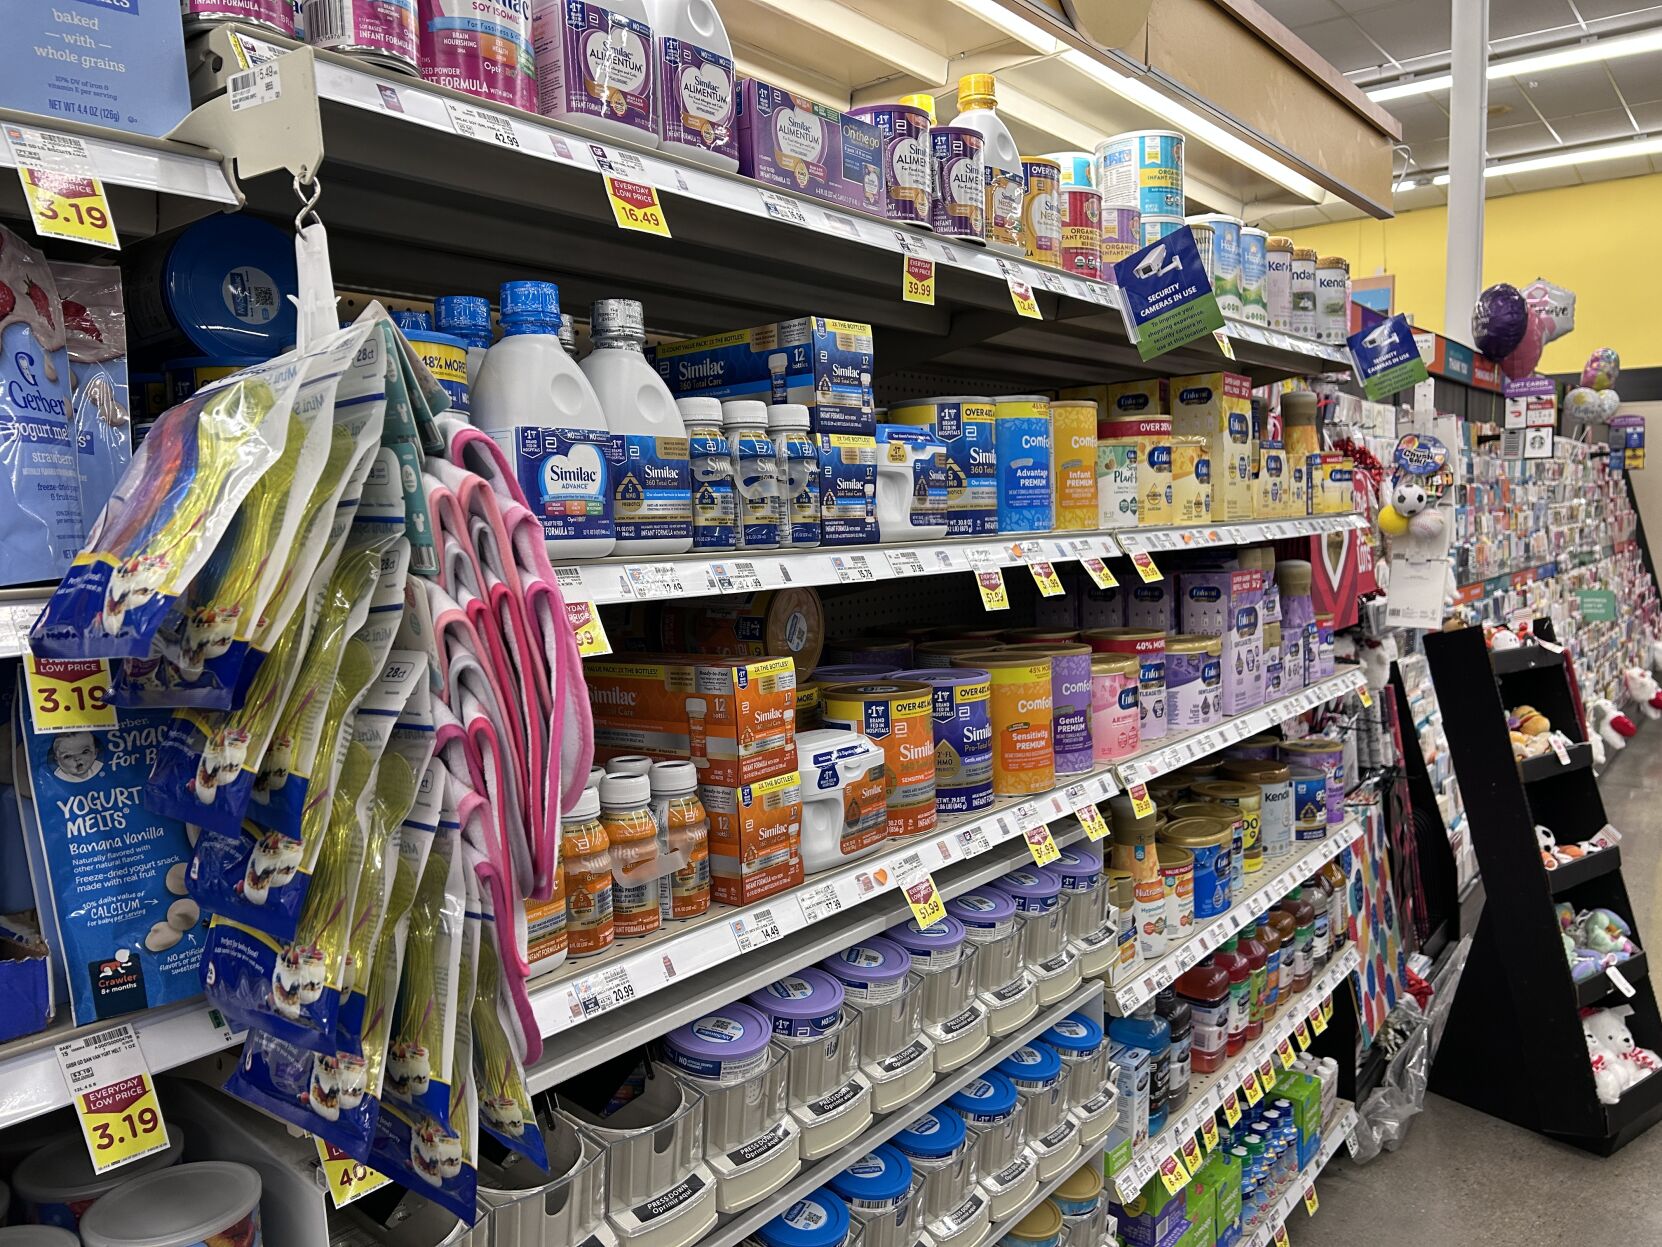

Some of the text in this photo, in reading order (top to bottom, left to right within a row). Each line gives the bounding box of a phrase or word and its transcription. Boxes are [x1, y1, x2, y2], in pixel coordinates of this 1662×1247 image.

[52, 8, 99, 30] baked
[472, 2, 492, 14] SOY
[493, 9, 521, 25] ISOMIL
[63, 32, 95, 48] with
[359, 30, 385, 42] INFANT
[385, 36, 412, 51] FORMULA
[443, 39, 478, 49] NOURISHING
[452, 32, 469, 40] BRAIN
[33, 45, 125, 73] whole grains
[258, 65, 273, 80] 5.49
[440, 77, 489, 93] FORMULA
[490, 87, 502, 96] WITH
[694, 75, 719, 94] Similac
[683, 83, 728, 106] ALIMENTUM
[48, 99, 120, 122] NET WT 4.4 OZ (126g)
[788, 115, 812, 133] Similac
[494, 132, 520, 147] 42.99
[778, 124, 820, 146] ALIMENTUM
[1032, 167, 1050, 176] OVER
[65, 181, 93, 194] PRICE
[614, 180, 650, 196] EVERYDAY
[615, 189, 653, 205] LOW PRICE
[37, 197, 108, 229] 3.19
[621, 206, 660, 228] 16.49
[934, 219, 952, 227] INFANT
[1070, 228, 1098, 236] ORGANIC
[1105, 243, 1135, 251] ORGANIC
[909, 260, 933, 269] EVERYDAY
[909, 281, 931, 298] 39.99
[1148, 283, 1179, 303] SECURITY
[1141, 286, 1197, 318] CAMERAS IN USE
[1148, 310, 1203, 339] shopping experience
[1152, 305, 1195, 328] To improve your
[1153, 331, 1175, 346] security
[1176, 322, 1196, 334] camera
[1157, 326, 1208, 352] use at this location
[356, 348, 374, 362] 28ct
[793, 348, 805, 362] 12
[1373, 351, 1397, 364] SECURITY
[679, 358, 725, 381] Similac
[832, 363, 860, 379] Similac
[9, 380, 65, 416] Gerber
[1140, 423, 1160, 432] OVER
[550, 464, 597, 483] Similac
[645, 464, 679, 479] Similac
[1017, 470, 1048, 479] Advantage
[1069, 471, 1090, 479] Infant
[561, 483, 589, 491] ADVANCE
[837, 477, 864, 491] Similac
[1020, 479, 1047, 488] PREMIUM
[1066, 479, 1093, 487] PREMIUM
[545, 525, 568, 536] FORMULA
[1136, 641, 1153, 651] 40%
[39, 663, 97, 673] LOW PRICE
[385, 667, 406, 679] 28ct
[37, 685, 109, 713] 3.19
[713, 698, 726, 711] 12
[754, 707, 783, 724] Similac
[1059, 716, 1084, 726] Gentle
[866, 727, 889, 735] HOSPITALS
[1012, 729, 1048, 741] Sensitivity
[1057, 723, 1086, 734] PREMIUM
[1016, 740, 1046, 751] PREMIUM
[108, 753, 139, 772] for
[902, 774, 925, 784] SENSITIVE
[862, 785, 883, 800] Similac
[57, 786, 142, 819] YOGURT
[718, 816, 730, 831] 12
[758, 822, 788, 841] Similac
[69, 826, 164, 856] Banana Vanilla
[72, 844, 151, 866] Naturally flavored with
[73, 853, 145, 874] other natural flavors
[75, 854, 179, 884] Freeze-dried yogurt snack
[77, 869, 156, 894] made with real fruit
[908, 881, 930, 895] EVERYDAY
[83, 889, 146, 911] 10% daily value of
[91, 898, 141, 919] CALCIUM
[919, 901, 940, 920] 51.99
[87, 908, 146, 929] for baby per serving
[761, 925, 780, 940] 14.49
[159, 957, 190, 972] flavors or
[98, 973, 137, 989] Crawler
[101, 981, 137, 994] 8+ months
[613, 985, 634, 1003] 20.99
[59, 1044, 72, 1052] BABY
[89, 1079, 139, 1102] EVERYDAY
[91, 1087, 143, 1111] LOW PRICE
[92, 1107, 158, 1151] 3.19
[647, 1183, 689, 1210] PRESS DOWN
